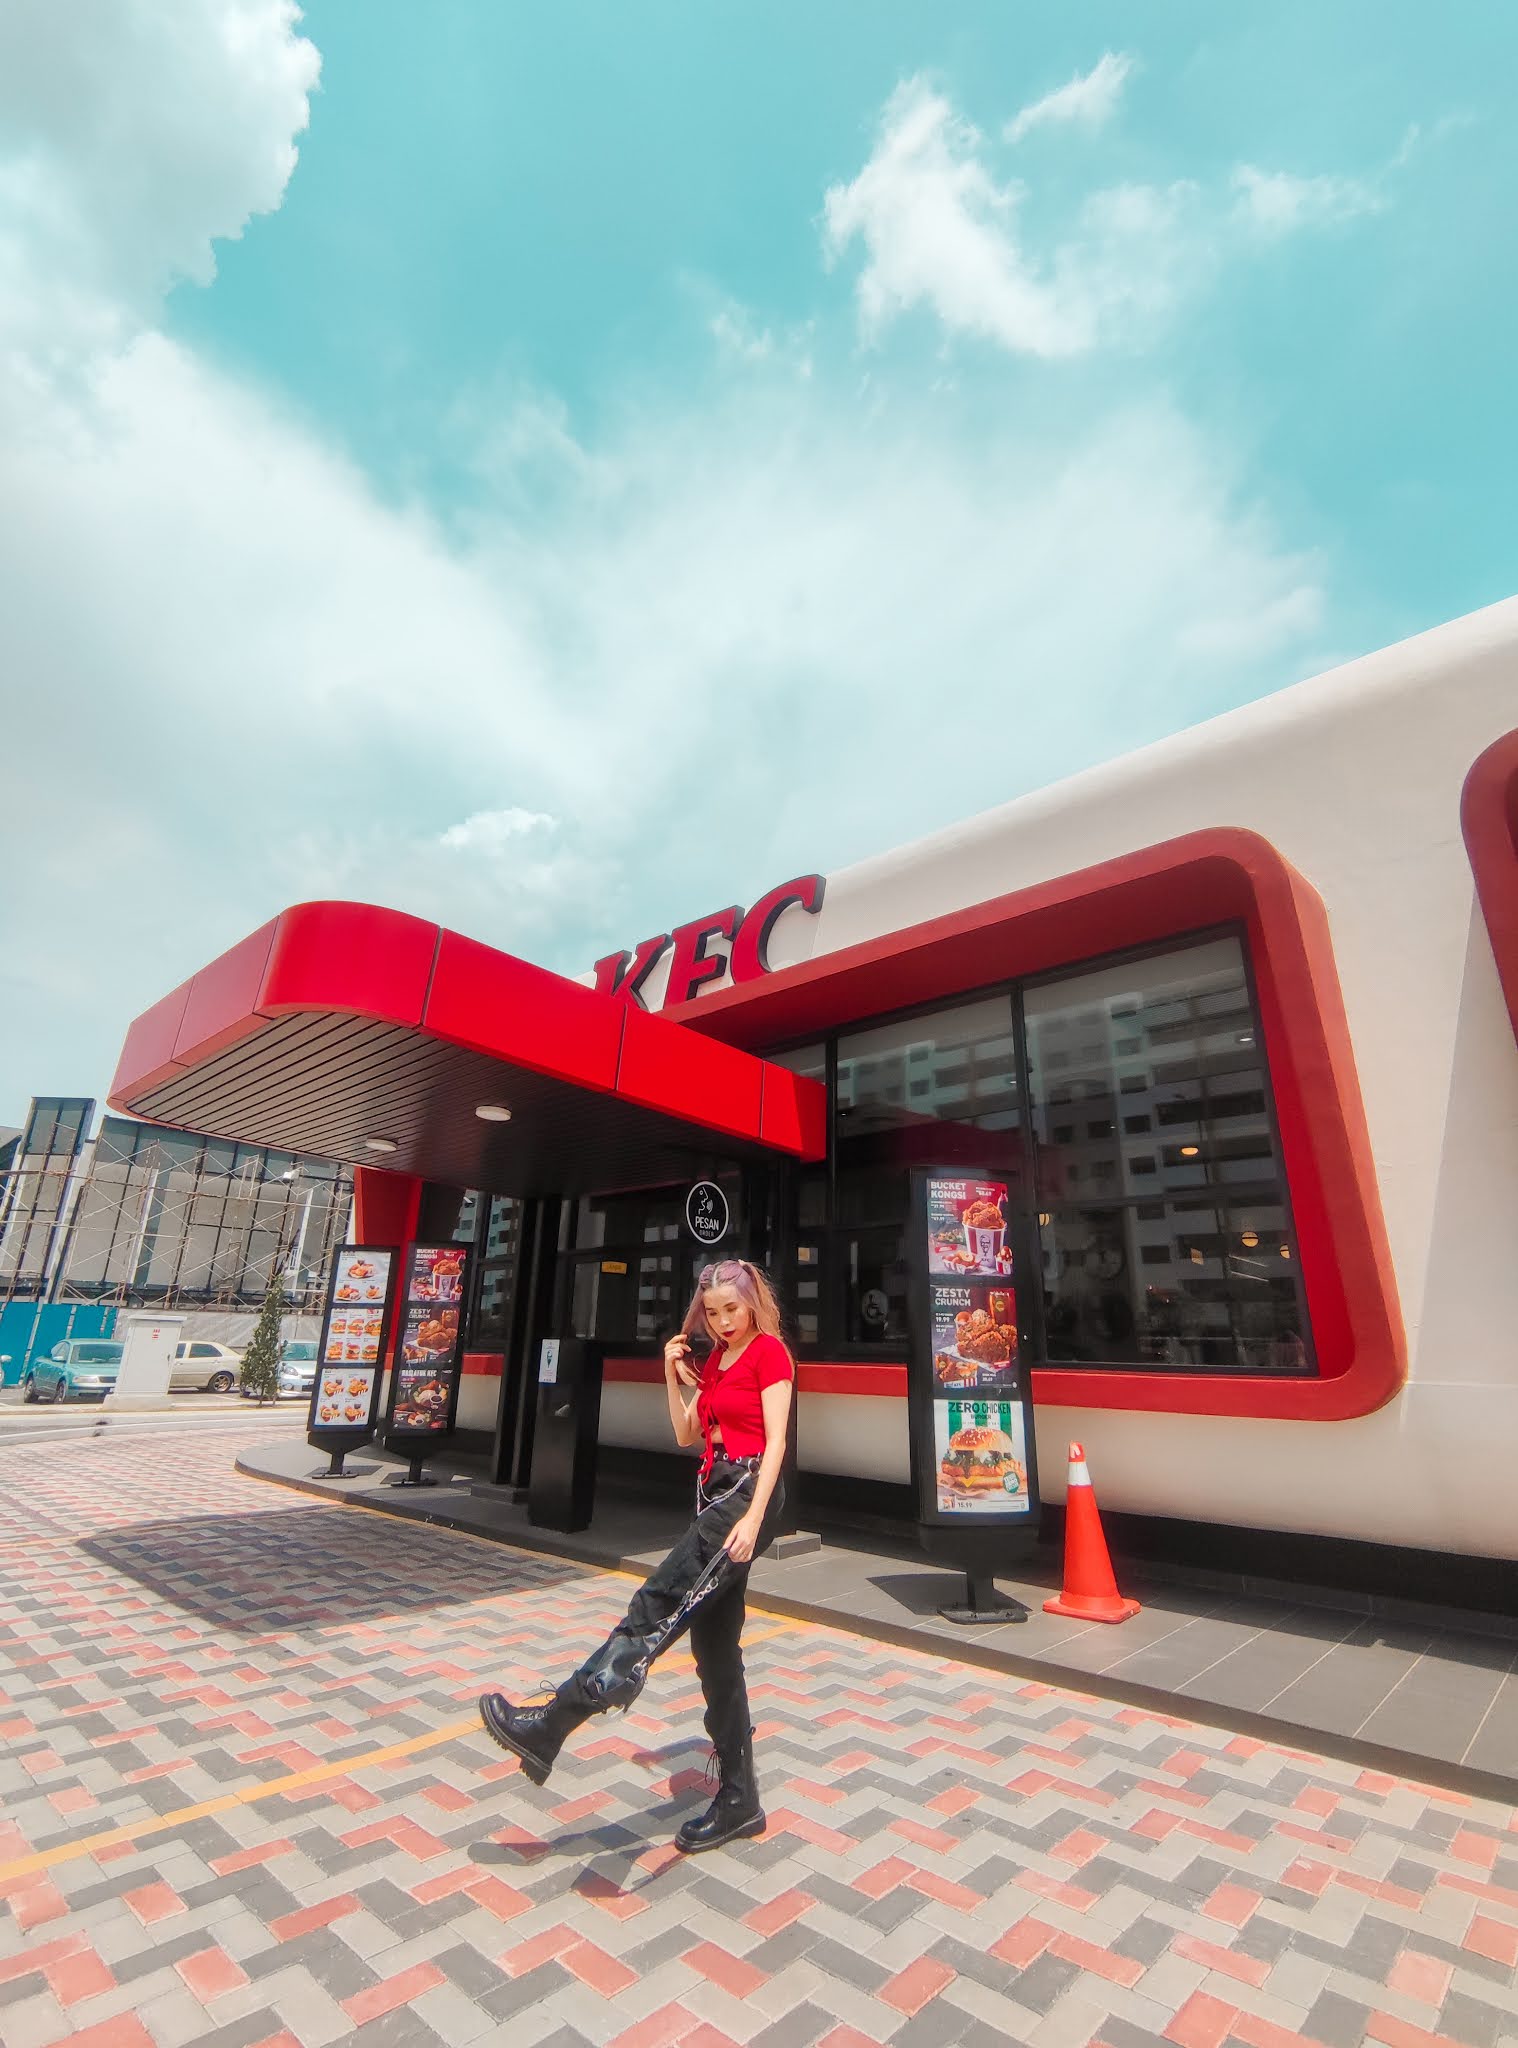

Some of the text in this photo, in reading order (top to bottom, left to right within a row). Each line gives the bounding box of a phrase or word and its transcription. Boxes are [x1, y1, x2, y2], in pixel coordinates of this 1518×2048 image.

[594, 874, 827, 1013] KFC
[930, 1181, 966, 1190] BUCKET
[930, 1190, 966, 1200] KONGSI
[695, 1216, 719, 1231] PESAN
[699, 1229, 715, 1237] ORDER
[935, 1288, 971, 1298] ZESTY
[935, 1298, 971, 1307] CRUNCH
[948, 1402, 1011, 1414] ZERO CHICKEN
